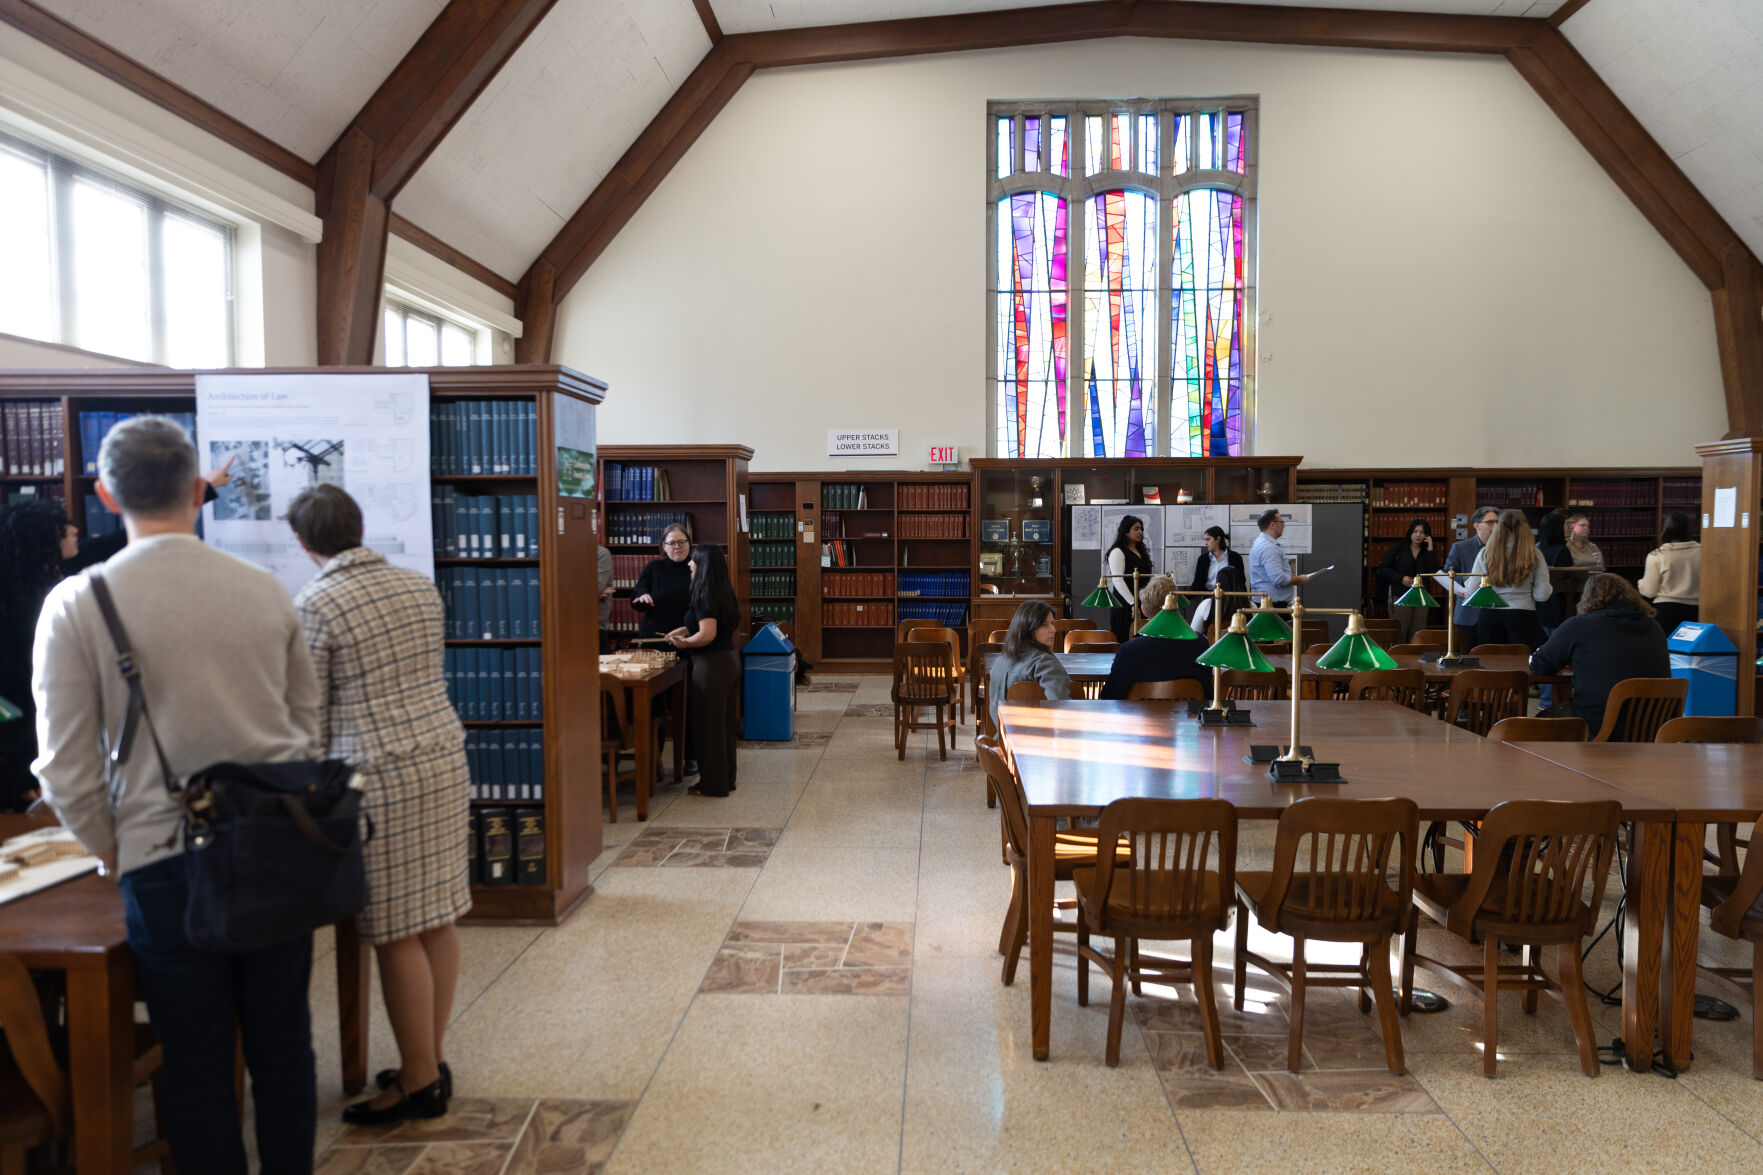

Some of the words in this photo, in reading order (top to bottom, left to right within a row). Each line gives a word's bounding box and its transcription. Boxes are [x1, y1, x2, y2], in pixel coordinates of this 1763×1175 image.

[208, 392, 258, 401] Architecture
[260, 391, 269, 401] of
[270, 391, 288, 401] Law
[930, 446, 954, 462] EXIT
